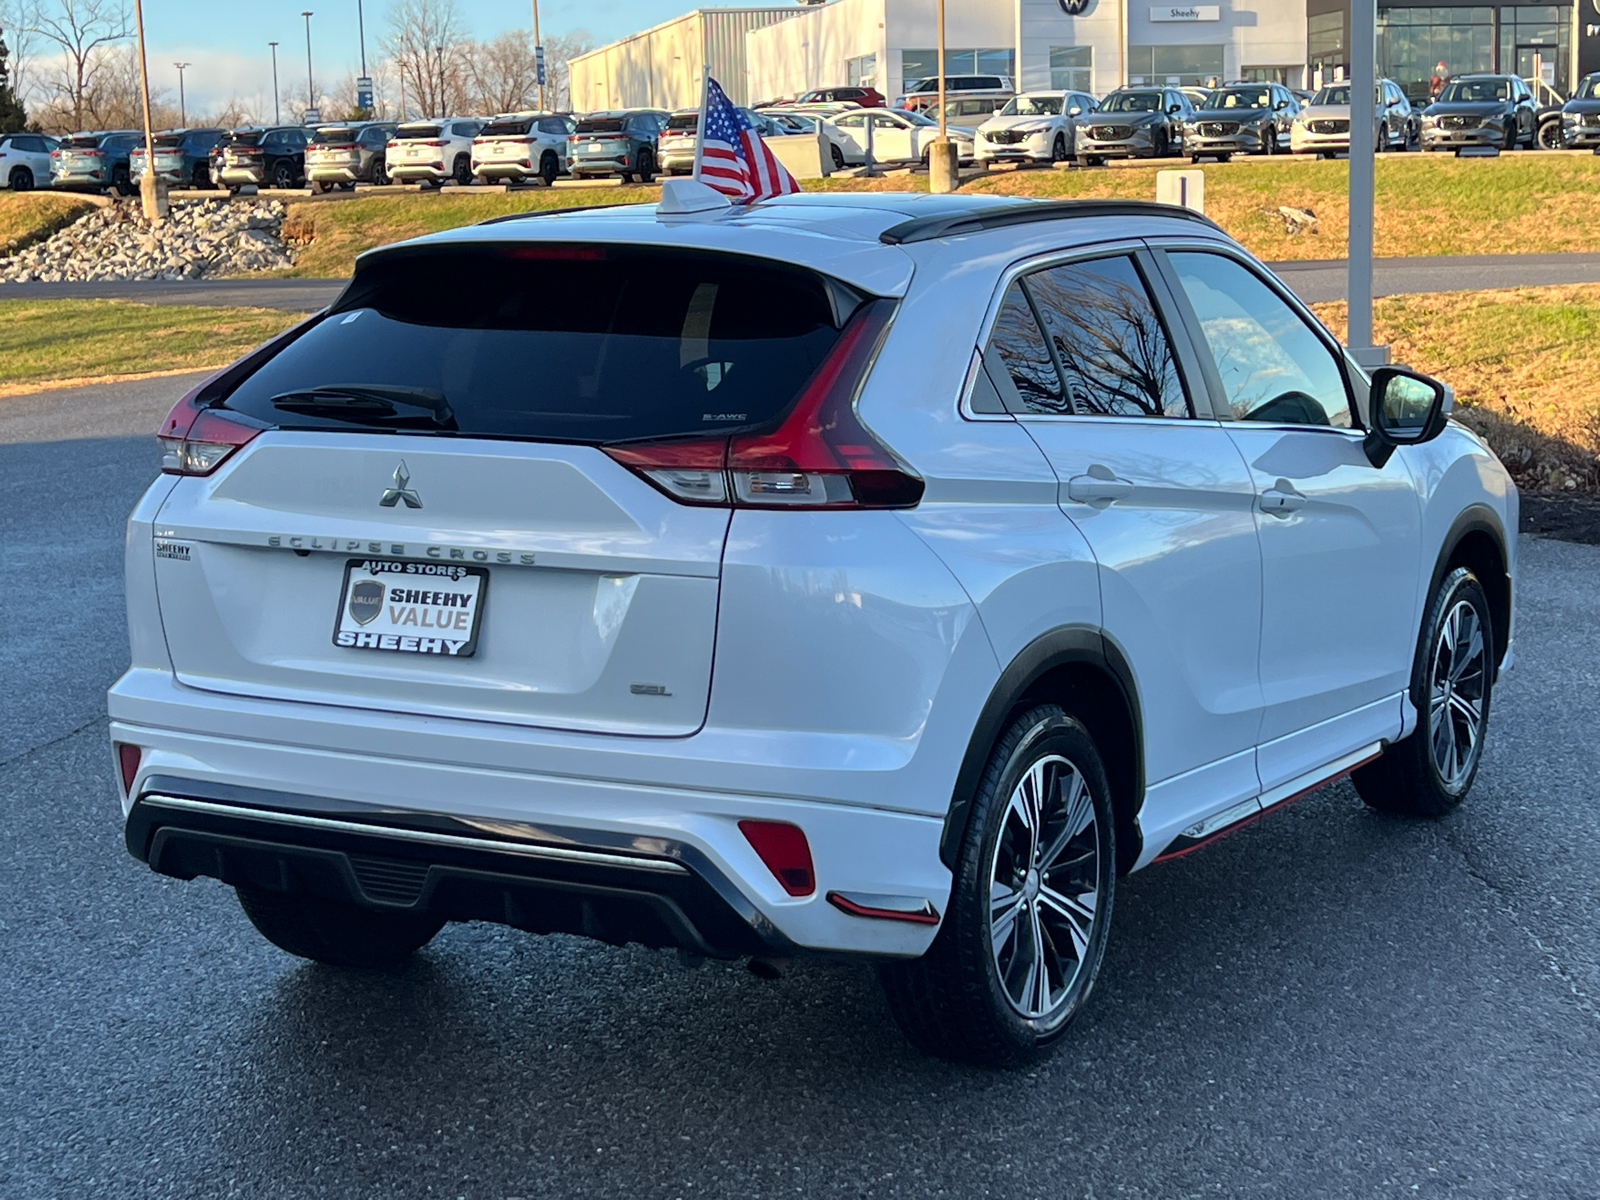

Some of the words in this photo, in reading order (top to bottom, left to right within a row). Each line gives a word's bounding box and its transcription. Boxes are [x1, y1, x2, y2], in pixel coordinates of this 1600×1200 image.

[1170, 8, 1200, 18] Sheehy
[156, 543, 190, 555] SHEEHY
[268, 536, 405, 555] ECLIPSE
[427, 546, 536, 565] CROSS
[361, 561, 402, 573] AUTO
[406, 564, 467, 577] STORES
[352, 595, 381, 605] VALUE
[389, 588, 473, 608] SHEEHY
[389, 605, 470, 631] VALUE
[337, 631, 467, 655] SHEEHY
